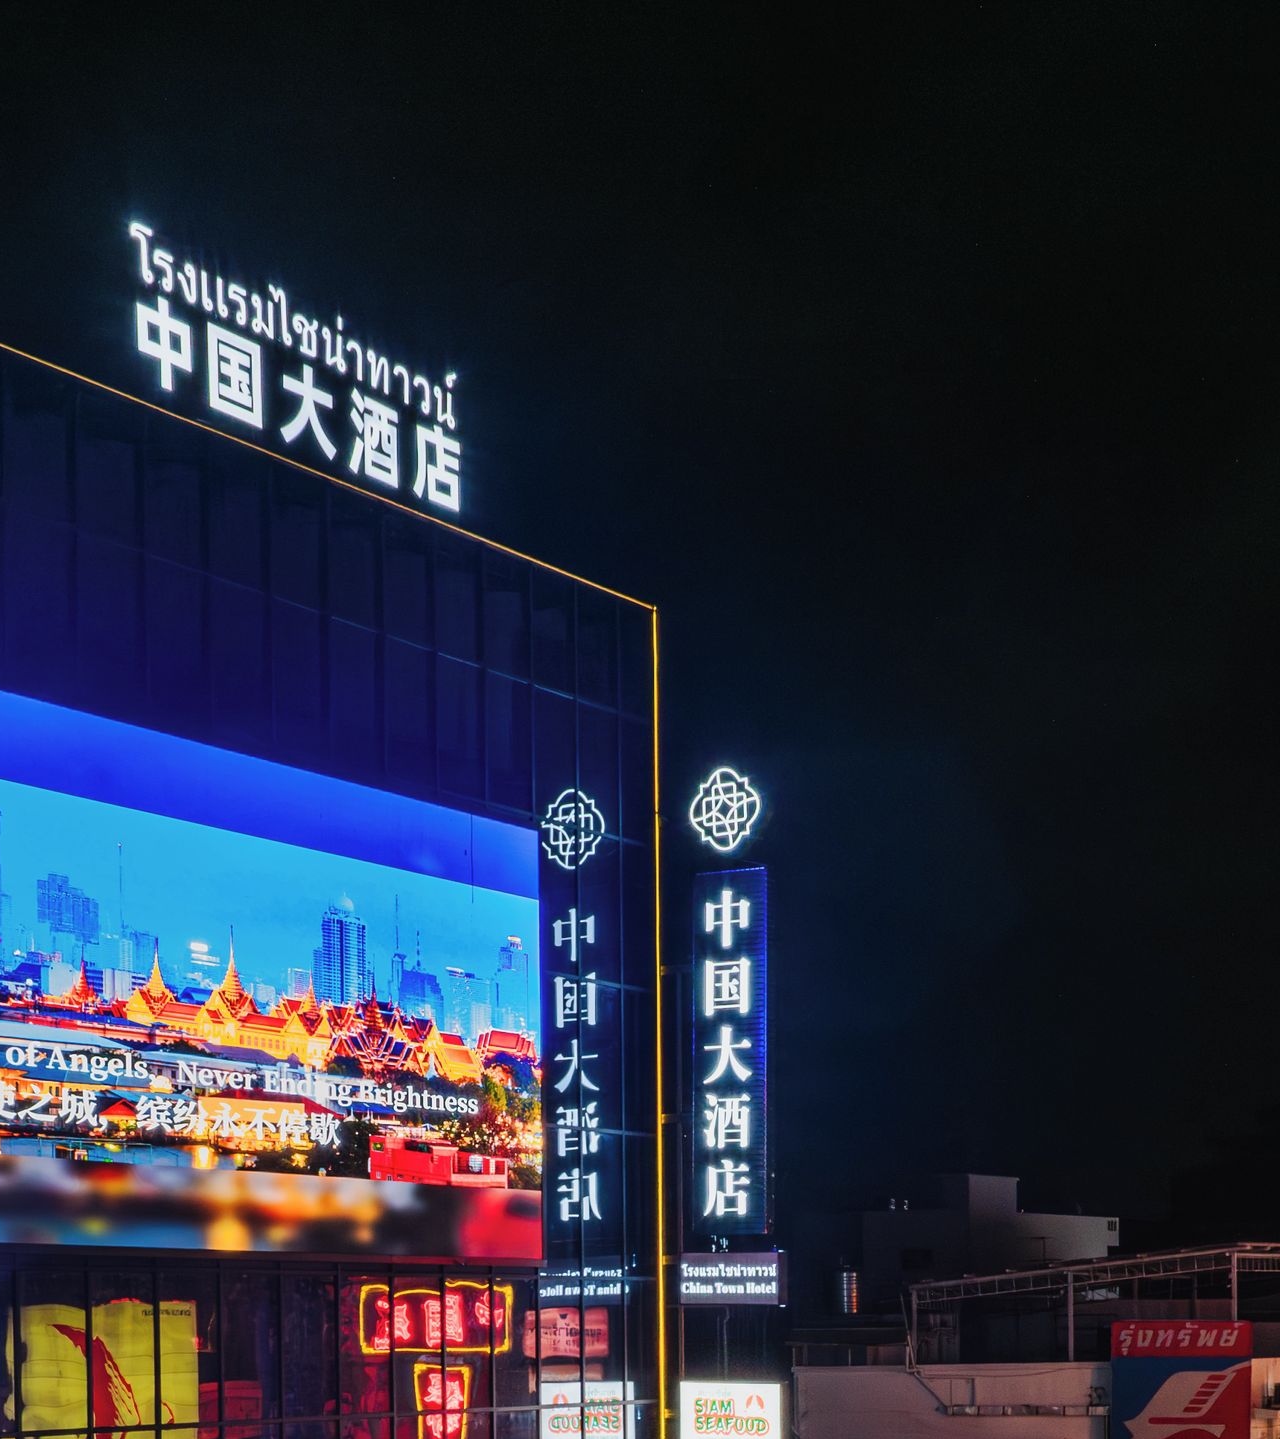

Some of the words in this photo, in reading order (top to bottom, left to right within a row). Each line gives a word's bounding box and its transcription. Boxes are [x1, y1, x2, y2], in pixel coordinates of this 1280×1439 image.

[130, 222, 456, 430] โรงแรมไชน่าทาวน์
[136, 296, 460, 512] 中国大酒店
[6, 1041, 40, 1068] of
[177, 1061, 259, 1091] Never
[263, 1062, 352, 1107] Ending
[359, 1081, 479, 1114] Brightness
[703, 889, 752, 1219] 中国大酒店
[682, 1281, 714, 1294] China
[715, 1281, 745, 1294] Town
[746, 1281, 777, 1294] Hotel
[1119, 1322, 1245, 1357] รุ่งทรัพย์
[694, 1399, 734, 1415] SIAM
[694, 1416, 768, 1433] SEAFOOD
